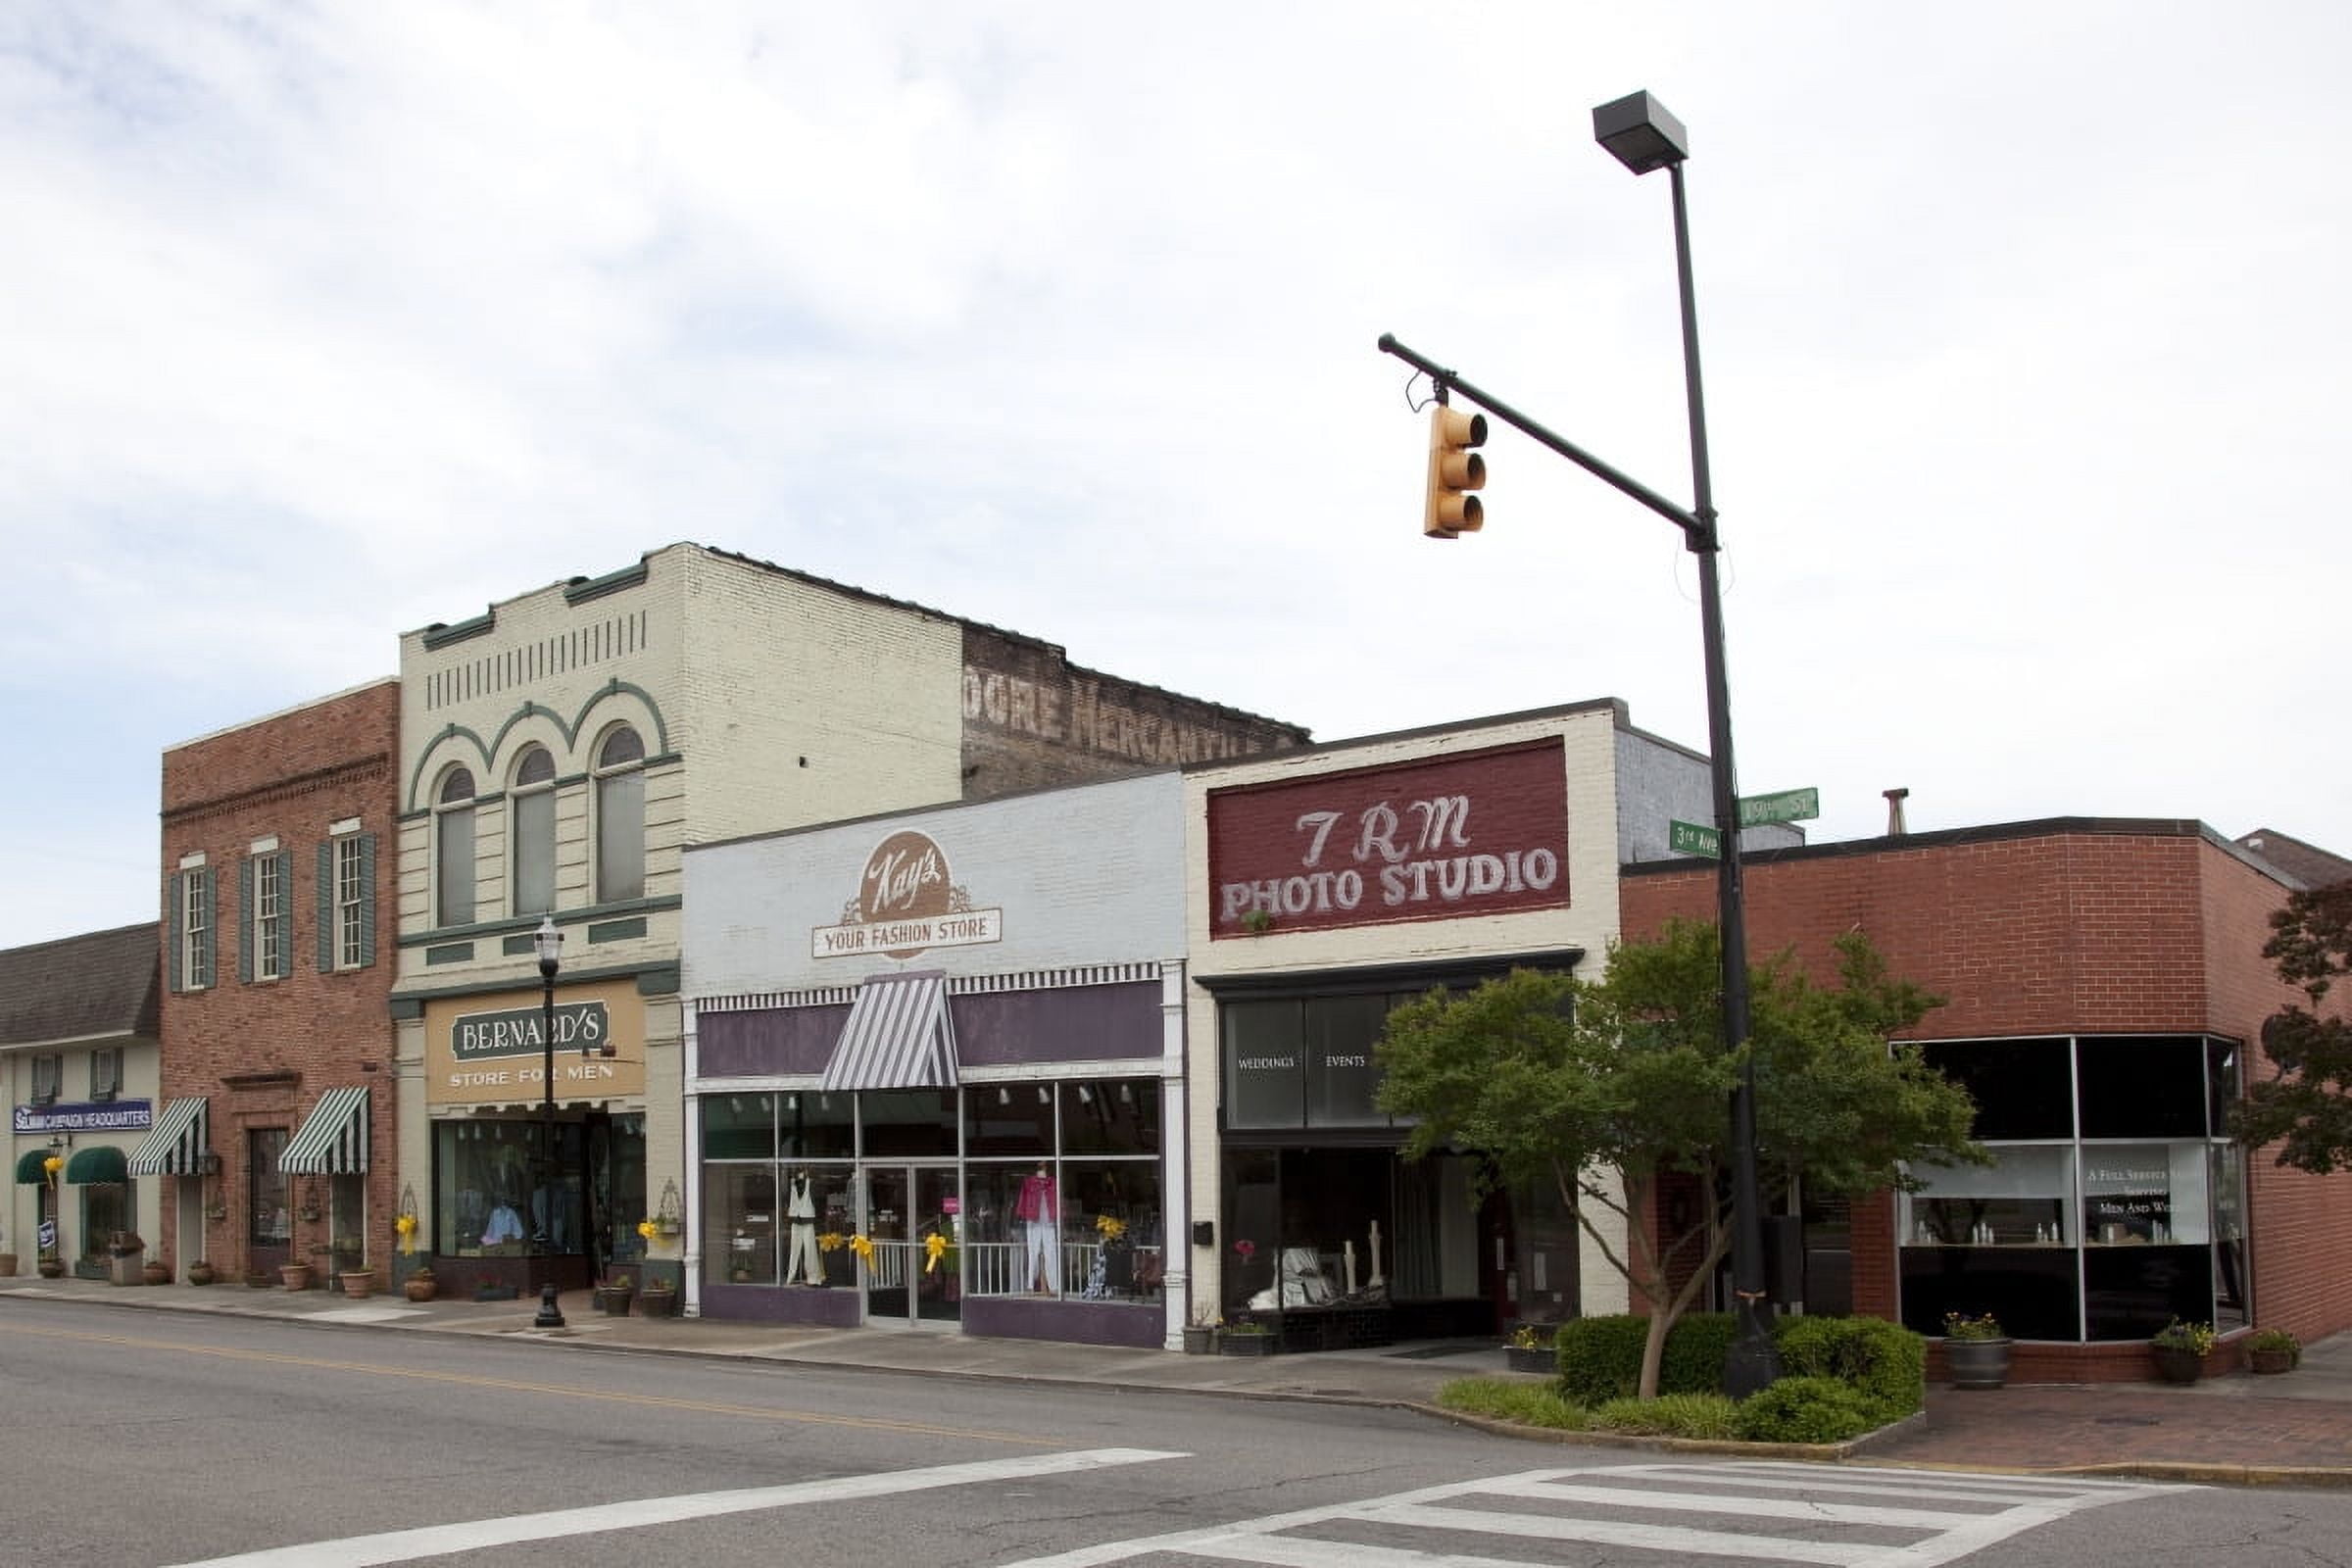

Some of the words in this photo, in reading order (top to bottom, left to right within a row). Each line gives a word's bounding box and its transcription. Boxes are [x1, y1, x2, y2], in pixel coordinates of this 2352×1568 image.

[867, 846, 942, 914] Kay's
[1219, 868, 1363, 921] PHOTO
[1379, 847, 1558, 906] STUDIO
[825, 930, 864, 952] YOUR
[872, 923, 932, 946] FASHION
[939, 916, 988, 940] STORE
[1238, 1056, 1295, 1070] WEDDINGS
[1325, 1054, 1365, 1068] EVENTS
[449, 1071, 511, 1088] STORE
[567, 1064, 613, 1081] MEN
[85, 1110, 151, 1127] HEADQUARTERS
